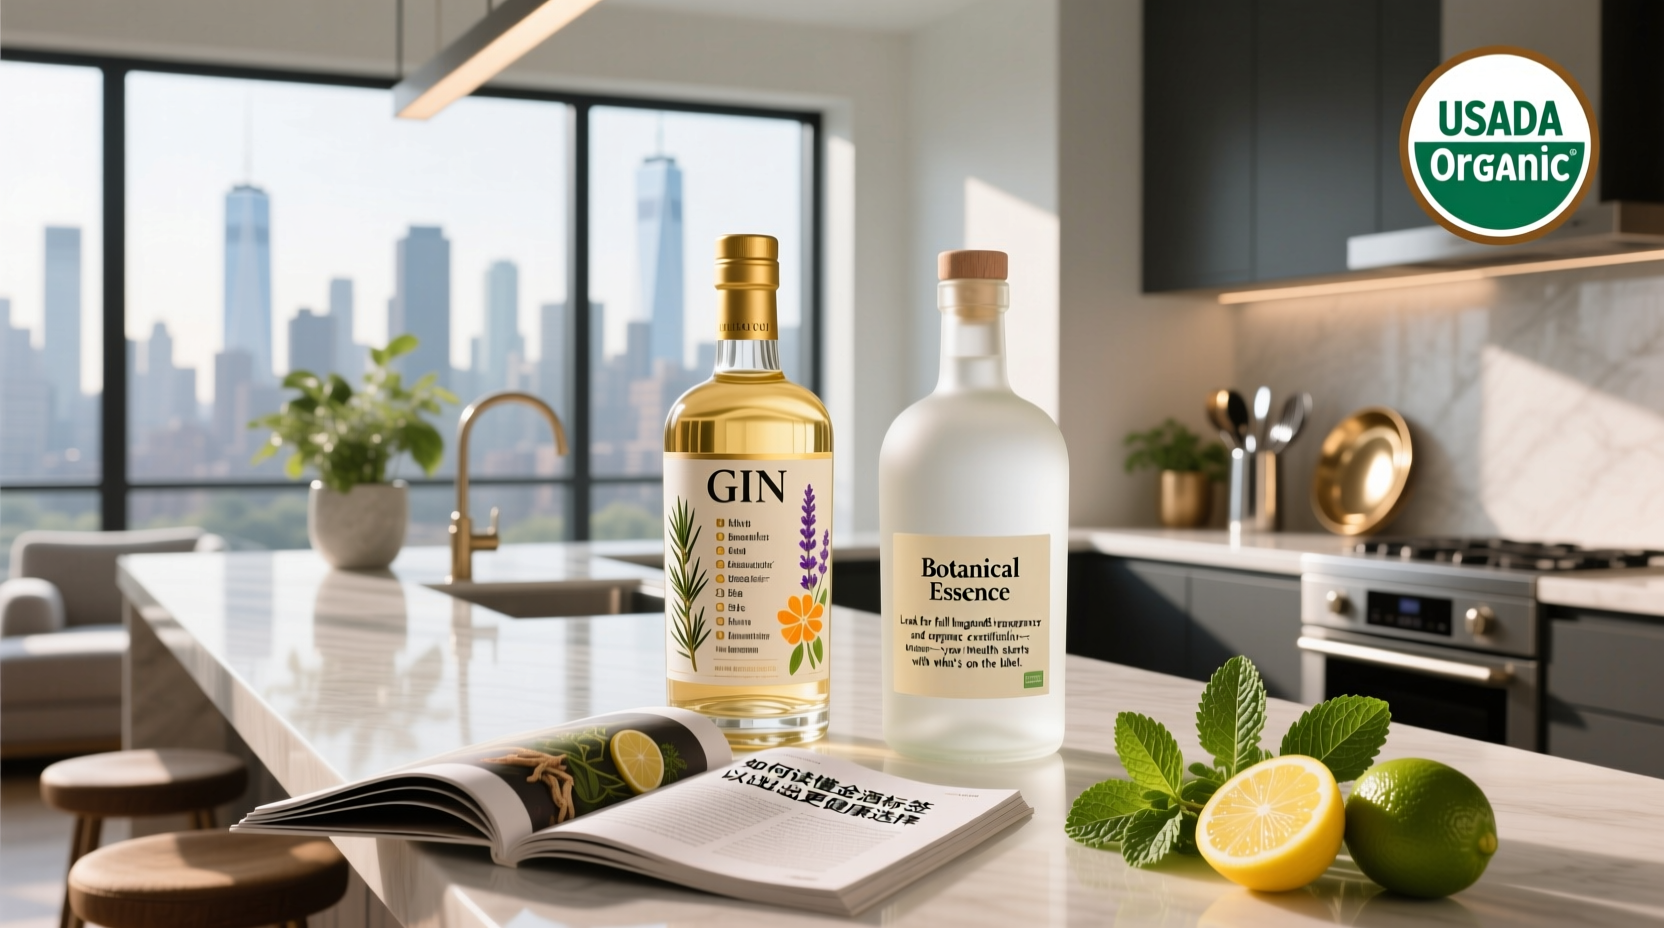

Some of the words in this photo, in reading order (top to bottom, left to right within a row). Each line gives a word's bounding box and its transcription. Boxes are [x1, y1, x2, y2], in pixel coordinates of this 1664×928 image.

[707, 469, 787, 503] GIN
[921, 556, 1020, 578] Botanical
[929, 581, 1010, 601] Essence
[966, 660, 979, 668] on
[981, 658, 996, 668] the
